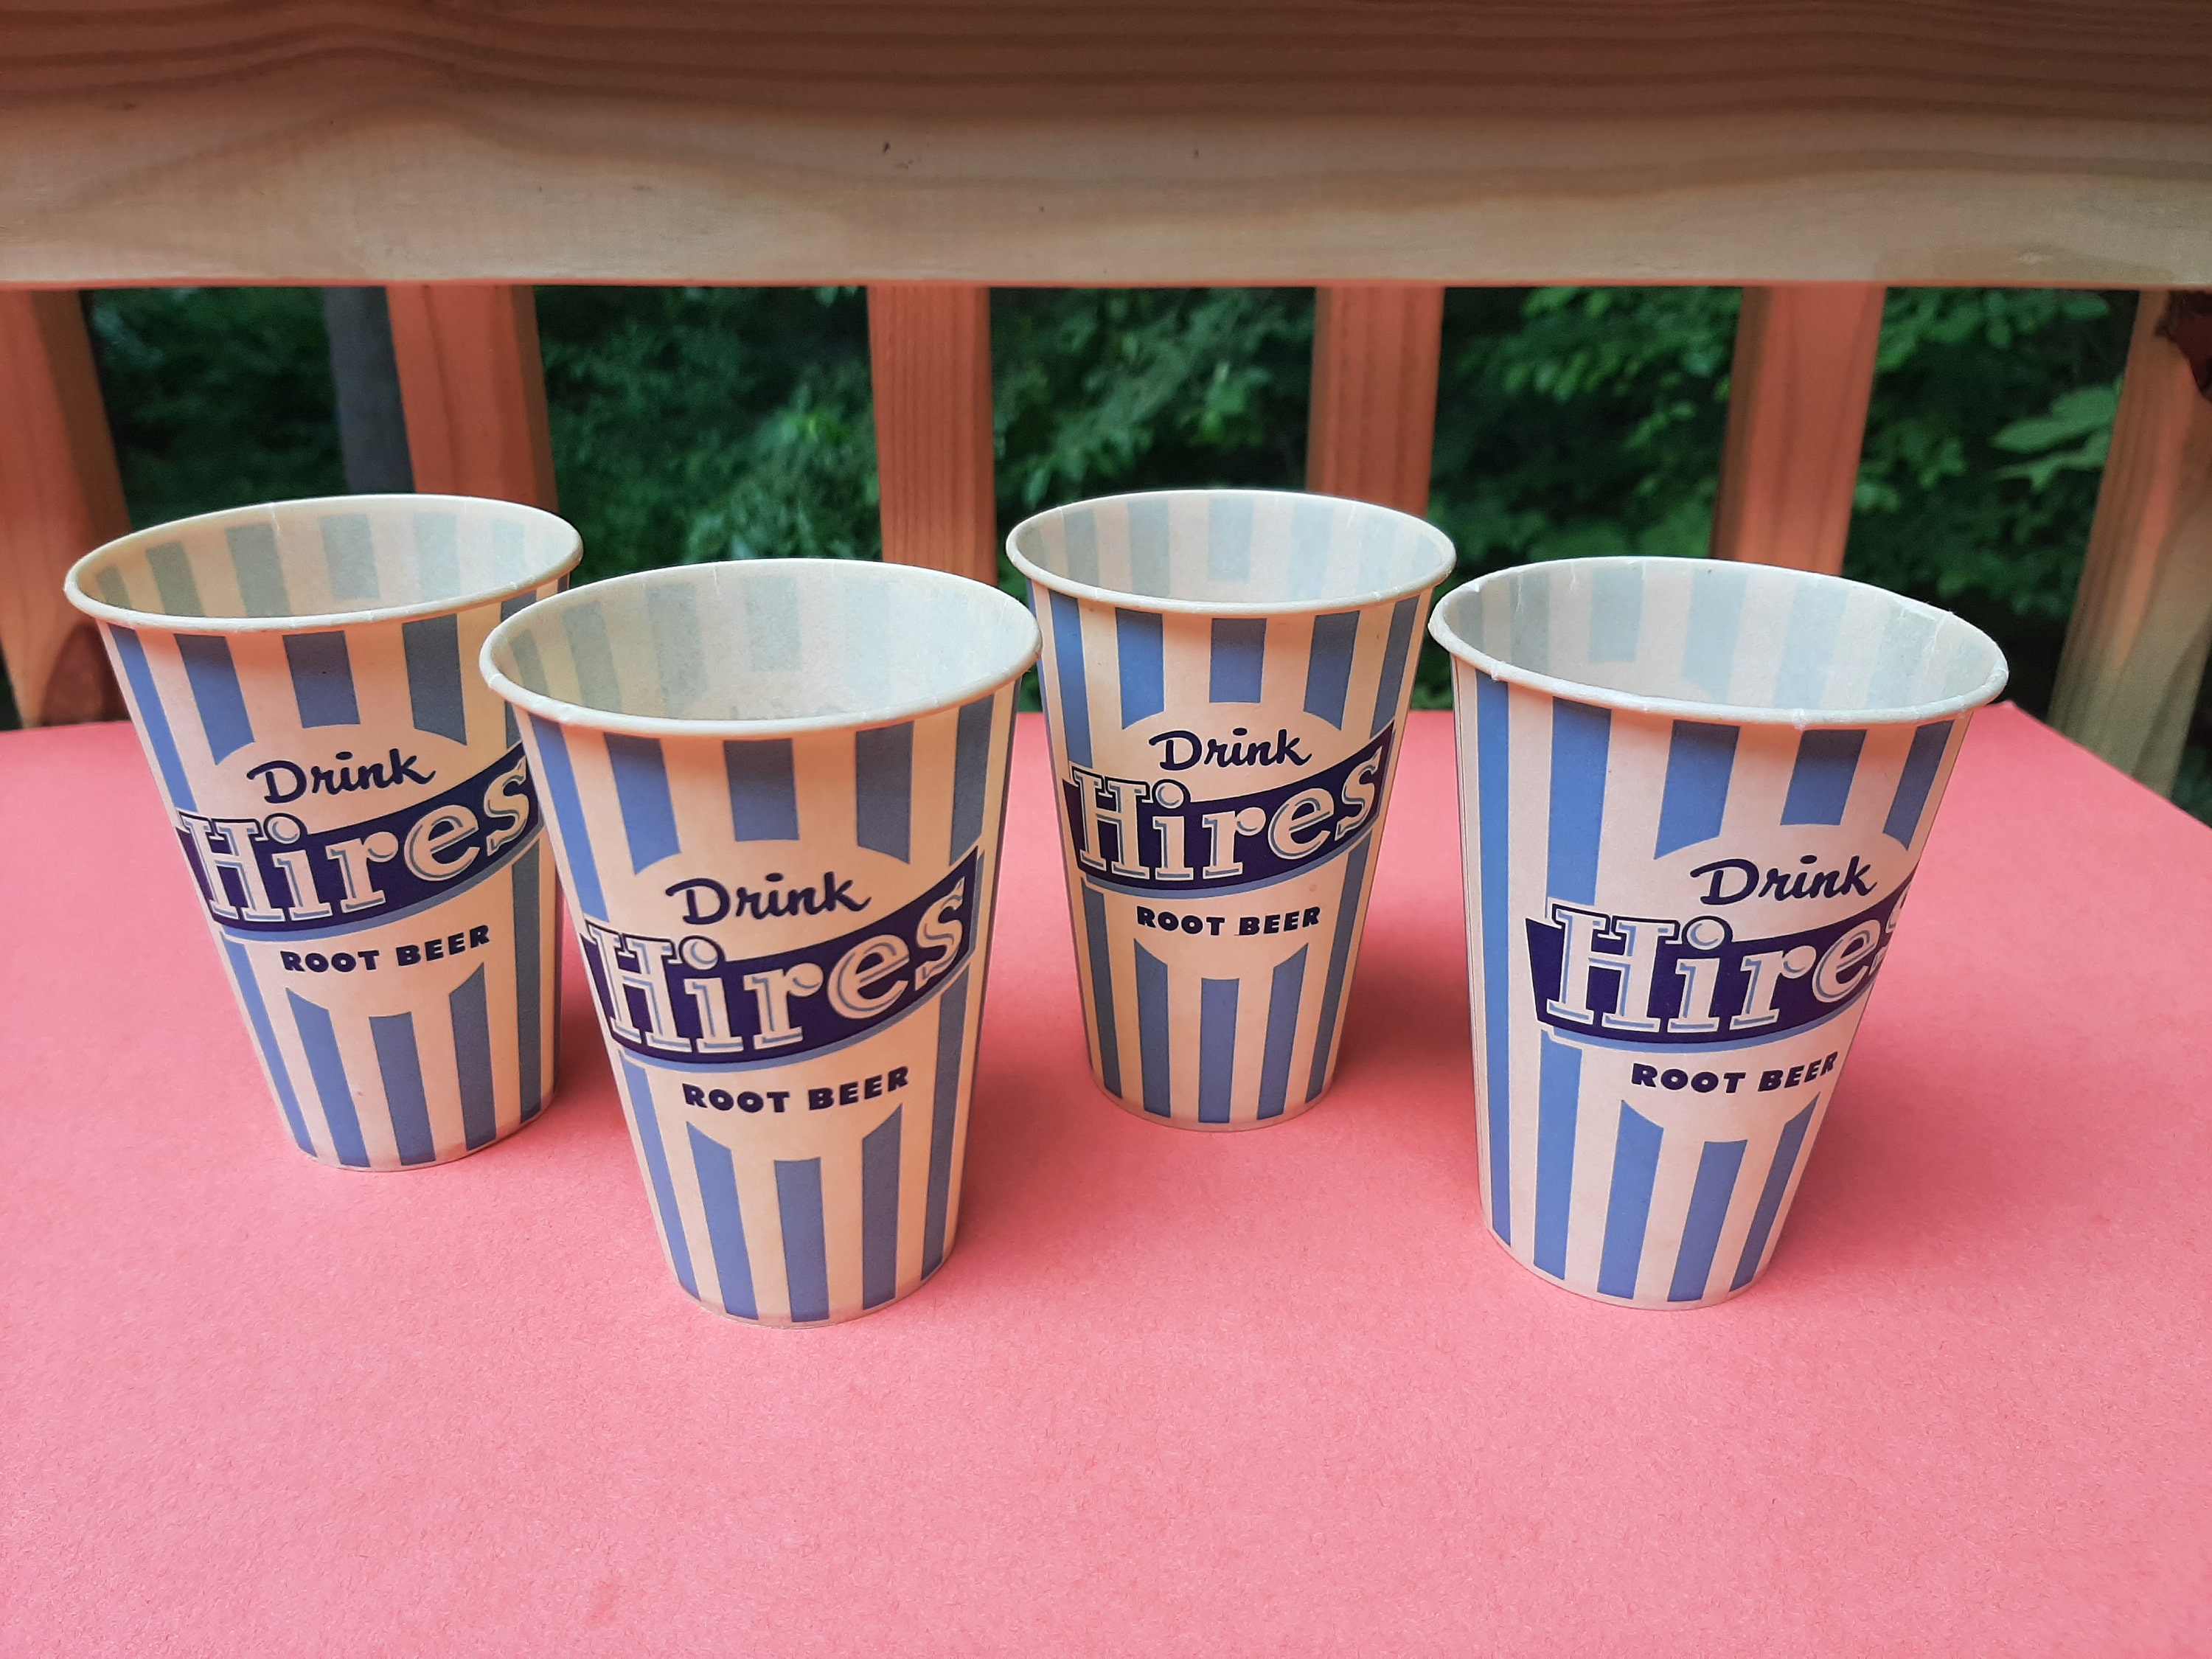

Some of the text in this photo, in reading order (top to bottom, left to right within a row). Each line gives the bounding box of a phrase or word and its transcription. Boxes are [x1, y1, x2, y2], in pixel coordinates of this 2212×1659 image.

[1148, 727, 1313, 771] Drink
[247, 748, 436, 804] Drink
[1073, 745, 1382, 881] Hires
[179, 756, 530, 922] Hires
[665, 872, 872, 926] Drink
[1689, 855, 1879, 905] Drink
[1137, 906, 1321, 936] ROOT BEER
[280, 925, 491, 973] ROOT BEER
[588, 877, 966, 1053] Hires
[682, 1066, 909, 1113] ROOT BEER
[1631, 1051, 1839, 1094] ROOT BEER
